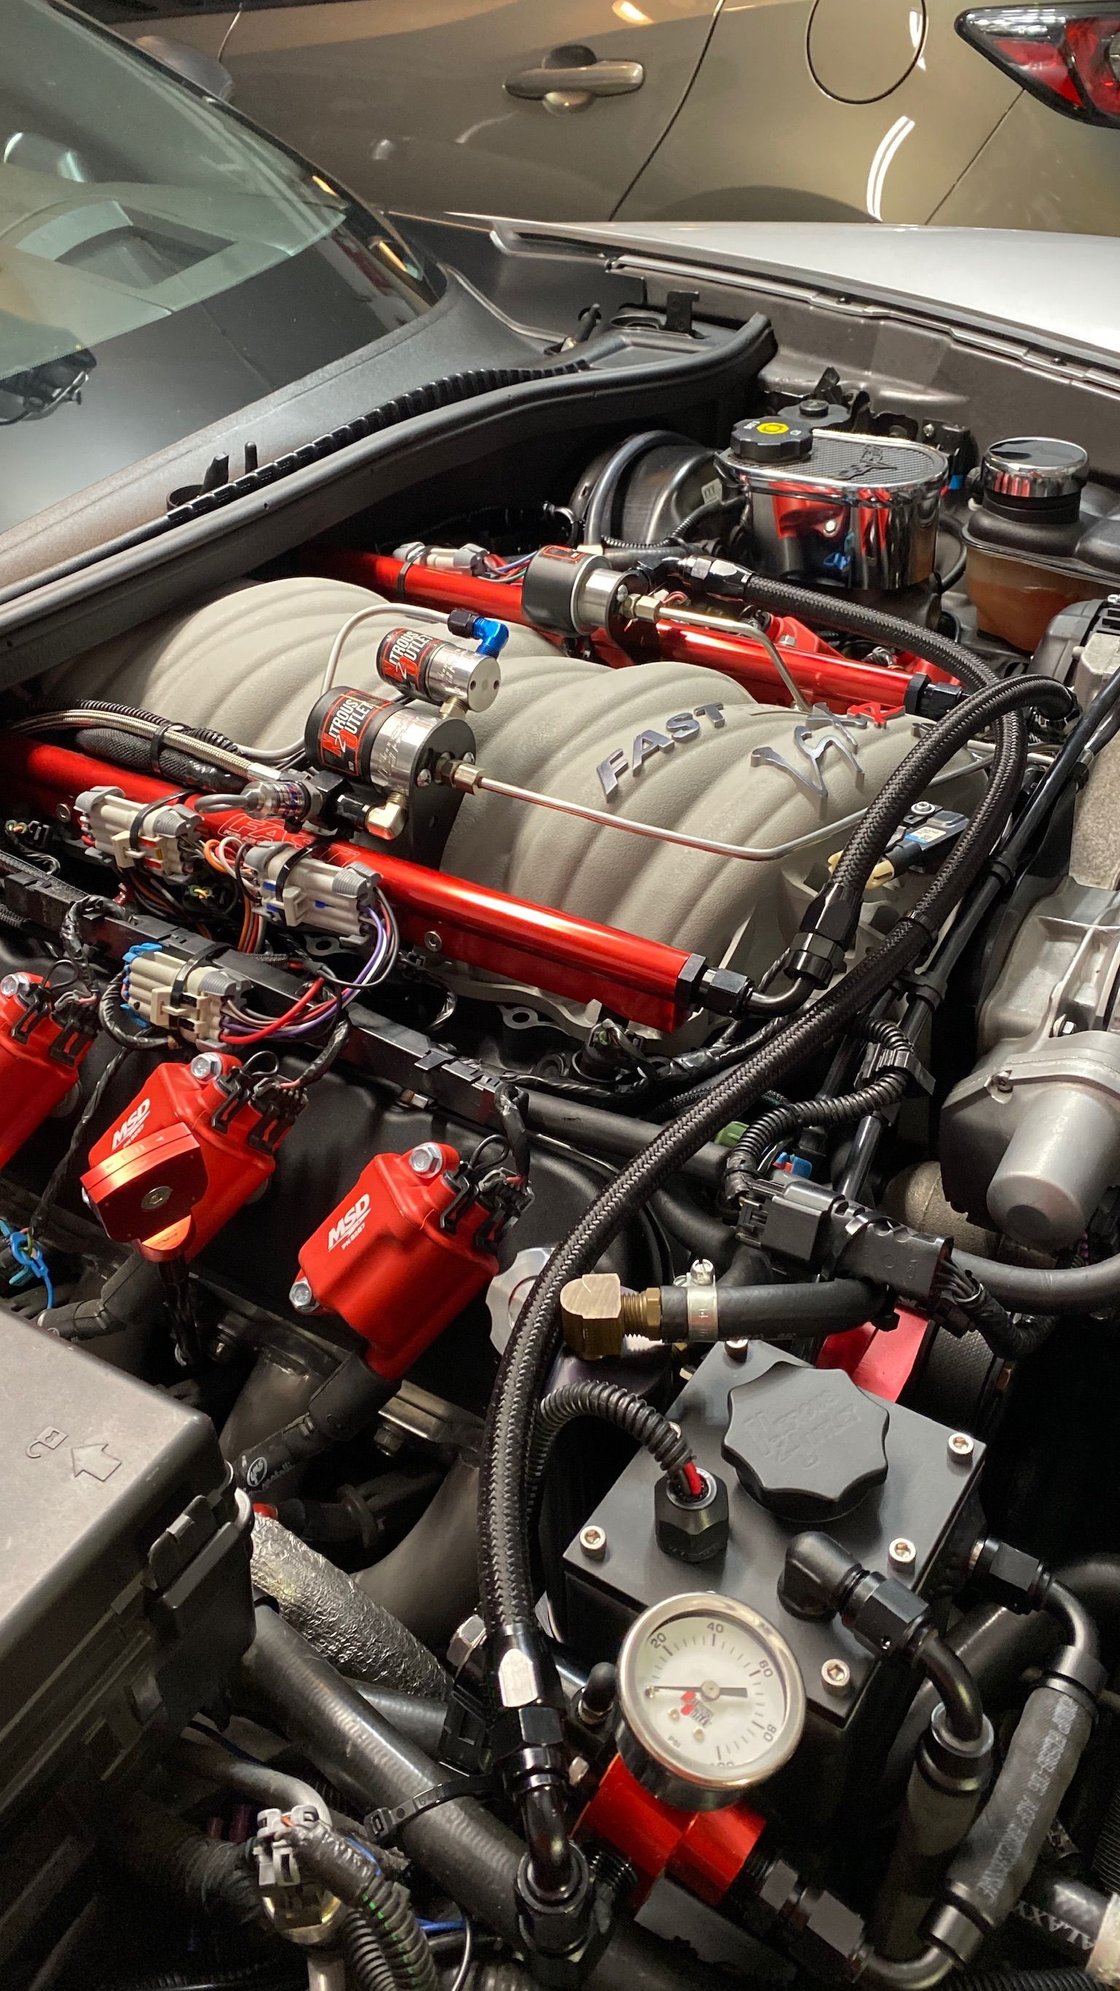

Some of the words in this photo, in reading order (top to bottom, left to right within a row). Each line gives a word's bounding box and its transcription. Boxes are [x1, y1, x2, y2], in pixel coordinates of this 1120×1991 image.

[596, 702, 725, 803] FAST
[112, 1098, 151, 1152] MSD
[328, 1193, 370, 1250] MSD
[650, 1632, 667, 1649] 20
[706, 1622, 724, 1634] 40
[763, 1723, 777, 1742] 80
